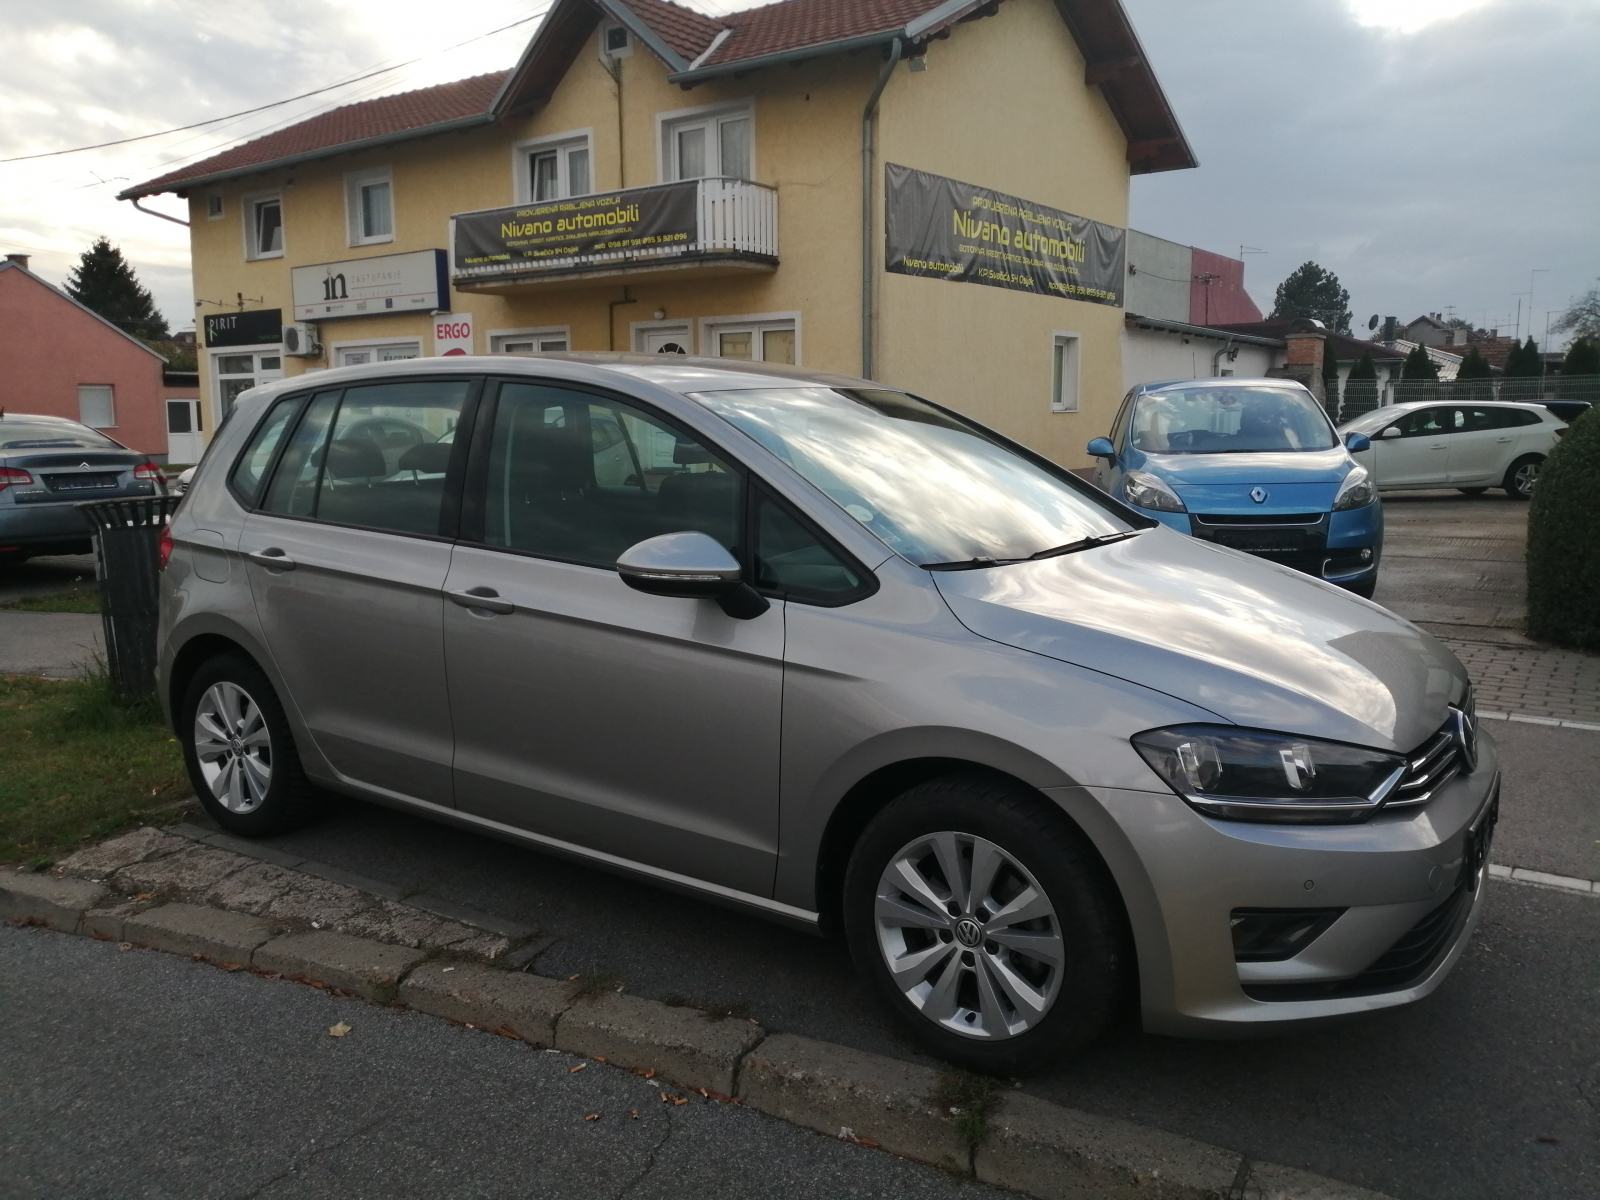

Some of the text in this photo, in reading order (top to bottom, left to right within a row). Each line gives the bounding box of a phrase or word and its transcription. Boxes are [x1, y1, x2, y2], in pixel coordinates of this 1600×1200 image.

[501, 203, 640, 239] Nivano automobili
[953, 208, 1085, 263] Nivano automobili
[903, 255, 965, 273] Nivano automobili
[436, 322, 470, 340] ERGO
